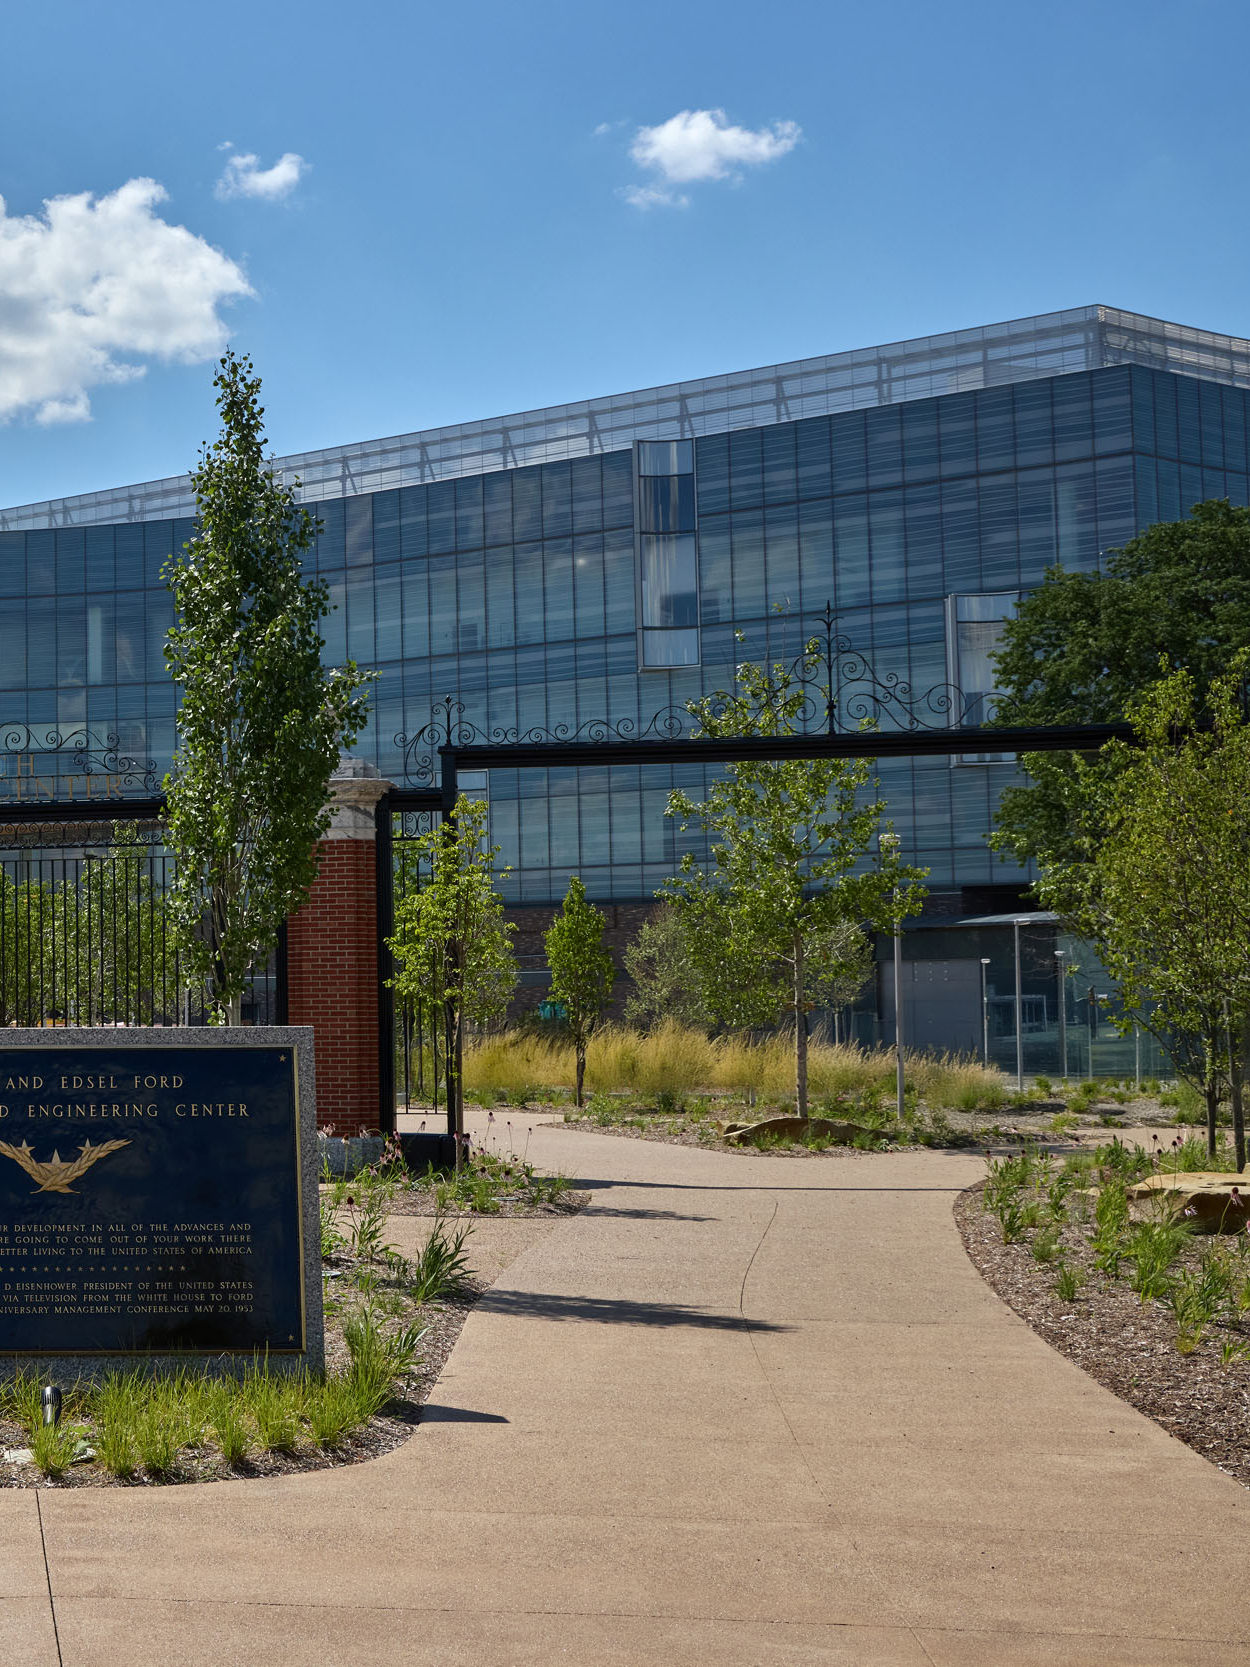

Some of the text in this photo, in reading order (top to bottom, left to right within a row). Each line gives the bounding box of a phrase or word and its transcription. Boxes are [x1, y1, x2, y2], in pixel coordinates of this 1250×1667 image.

[5, 1076, 44, 1089] AND
[61, 1076, 118, 1089] EDSEL
[134, 1075, 183, 1089] FORD
[28, 1103, 158, 1118] ENGINEERING
[175, 1103, 250, 1117] CENTER
[91, 1224, 103, 1232] IN
[107, 1224, 126, 1232] ALL
[131, 1223, 143, 1232] OF
[149, 1223, 168, 1232] THE
[173, 1223, 224, 1232] ADVANCES
[229, 1223, 251, 1231] AND
[14, 1235, 50, 1244] GOING
[55, 1235, 69, 1244] TO
[74, 1235, 103, 1244] COME
[109, 1235, 130, 1244] OUT
[135, 1235, 148, 1244] OF
[153, 1235, 179, 1243] YOUR
[220, 1234, 252, 1243] THERE
[33, 1247, 66, 1256] LIVING
[70, 1247, 84, 1256] TO
[87, 1247, 106, 1256] THE
[111, 1247, 148, 1256] UNITED
[152, 1247, 186, 1255] STATES
[190, 1246, 203, 1255] OF
[207, 1246, 253, 1255] AMERICA
[83, 1282, 133, 1291] PRESIDENT
[137, 1282, 150, 1290] OF
[154, 1282, 173, 1290] THE
[179, 1281, 215, 1290] UNITED
[220, 1281, 253, 1290] STATES
[2, 1294, 19, 1303] VIA
[23, 1294, 78, 1303] TELEVISION
[83, 1294, 109, 1302] FROM
[114, 1293, 132, 1302] THE
[137, 1293, 168, 1302] WHITE
[173, 1293, 206, 1302] HOUSE
[209, 1293, 223, 1301] TO
[228, 1293, 254, 1301] FORD
[54, 1305, 121, 1314] MANAGEMENT
[126, 1305, 189, 1314] CONFERENCE
[194, 1305, 215, 1313] MAY
[235, 1304, 254, 1313] 1953
